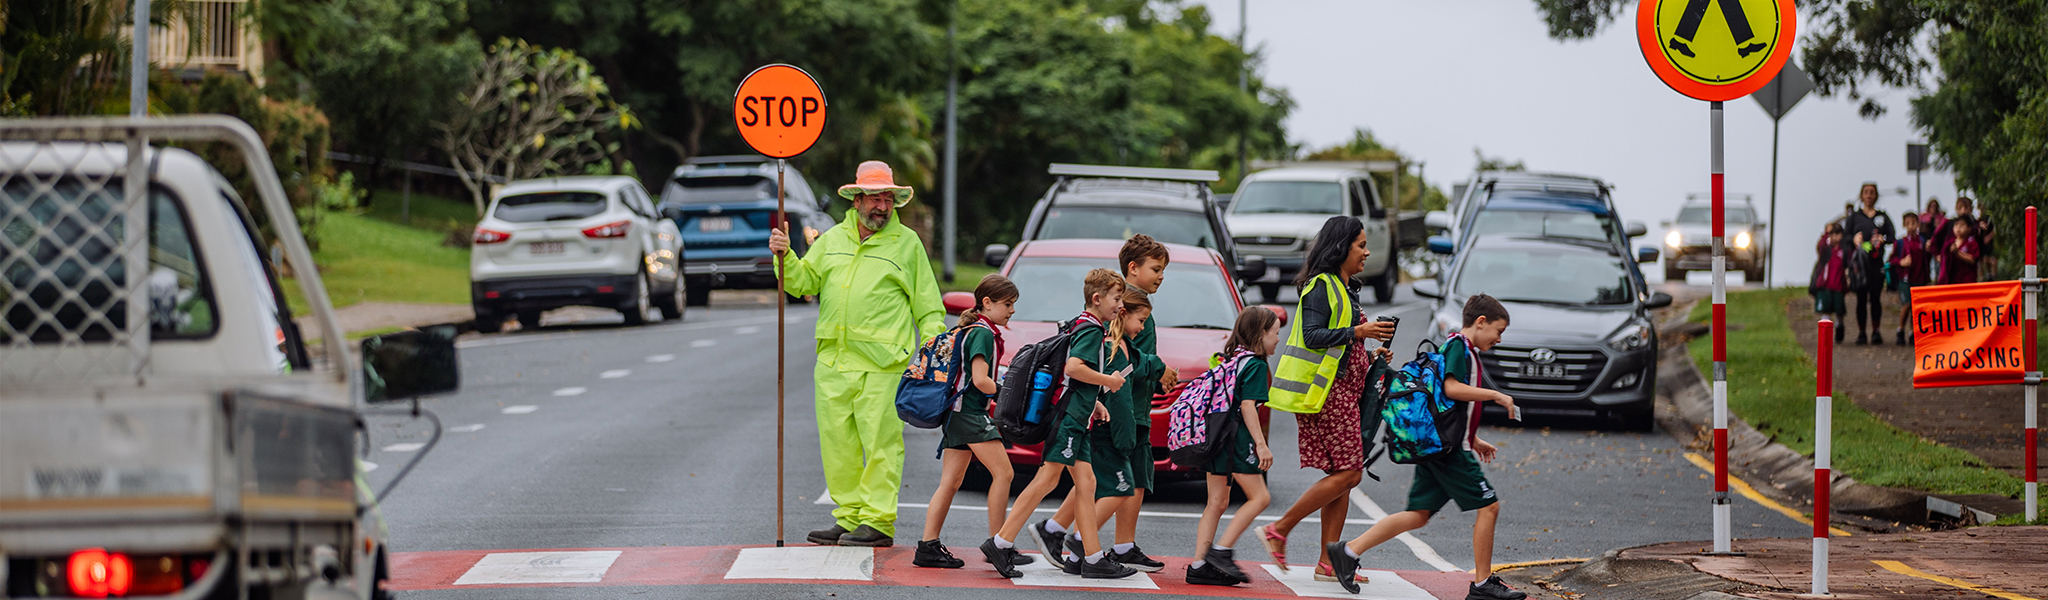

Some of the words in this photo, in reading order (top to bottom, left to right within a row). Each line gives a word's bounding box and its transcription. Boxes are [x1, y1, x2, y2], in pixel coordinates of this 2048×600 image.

[741, 95, 819, 127] STOP
[1918, 304, 2018, 334] CHILDREN
[1922, 347, 2020, 370] CROSSING
